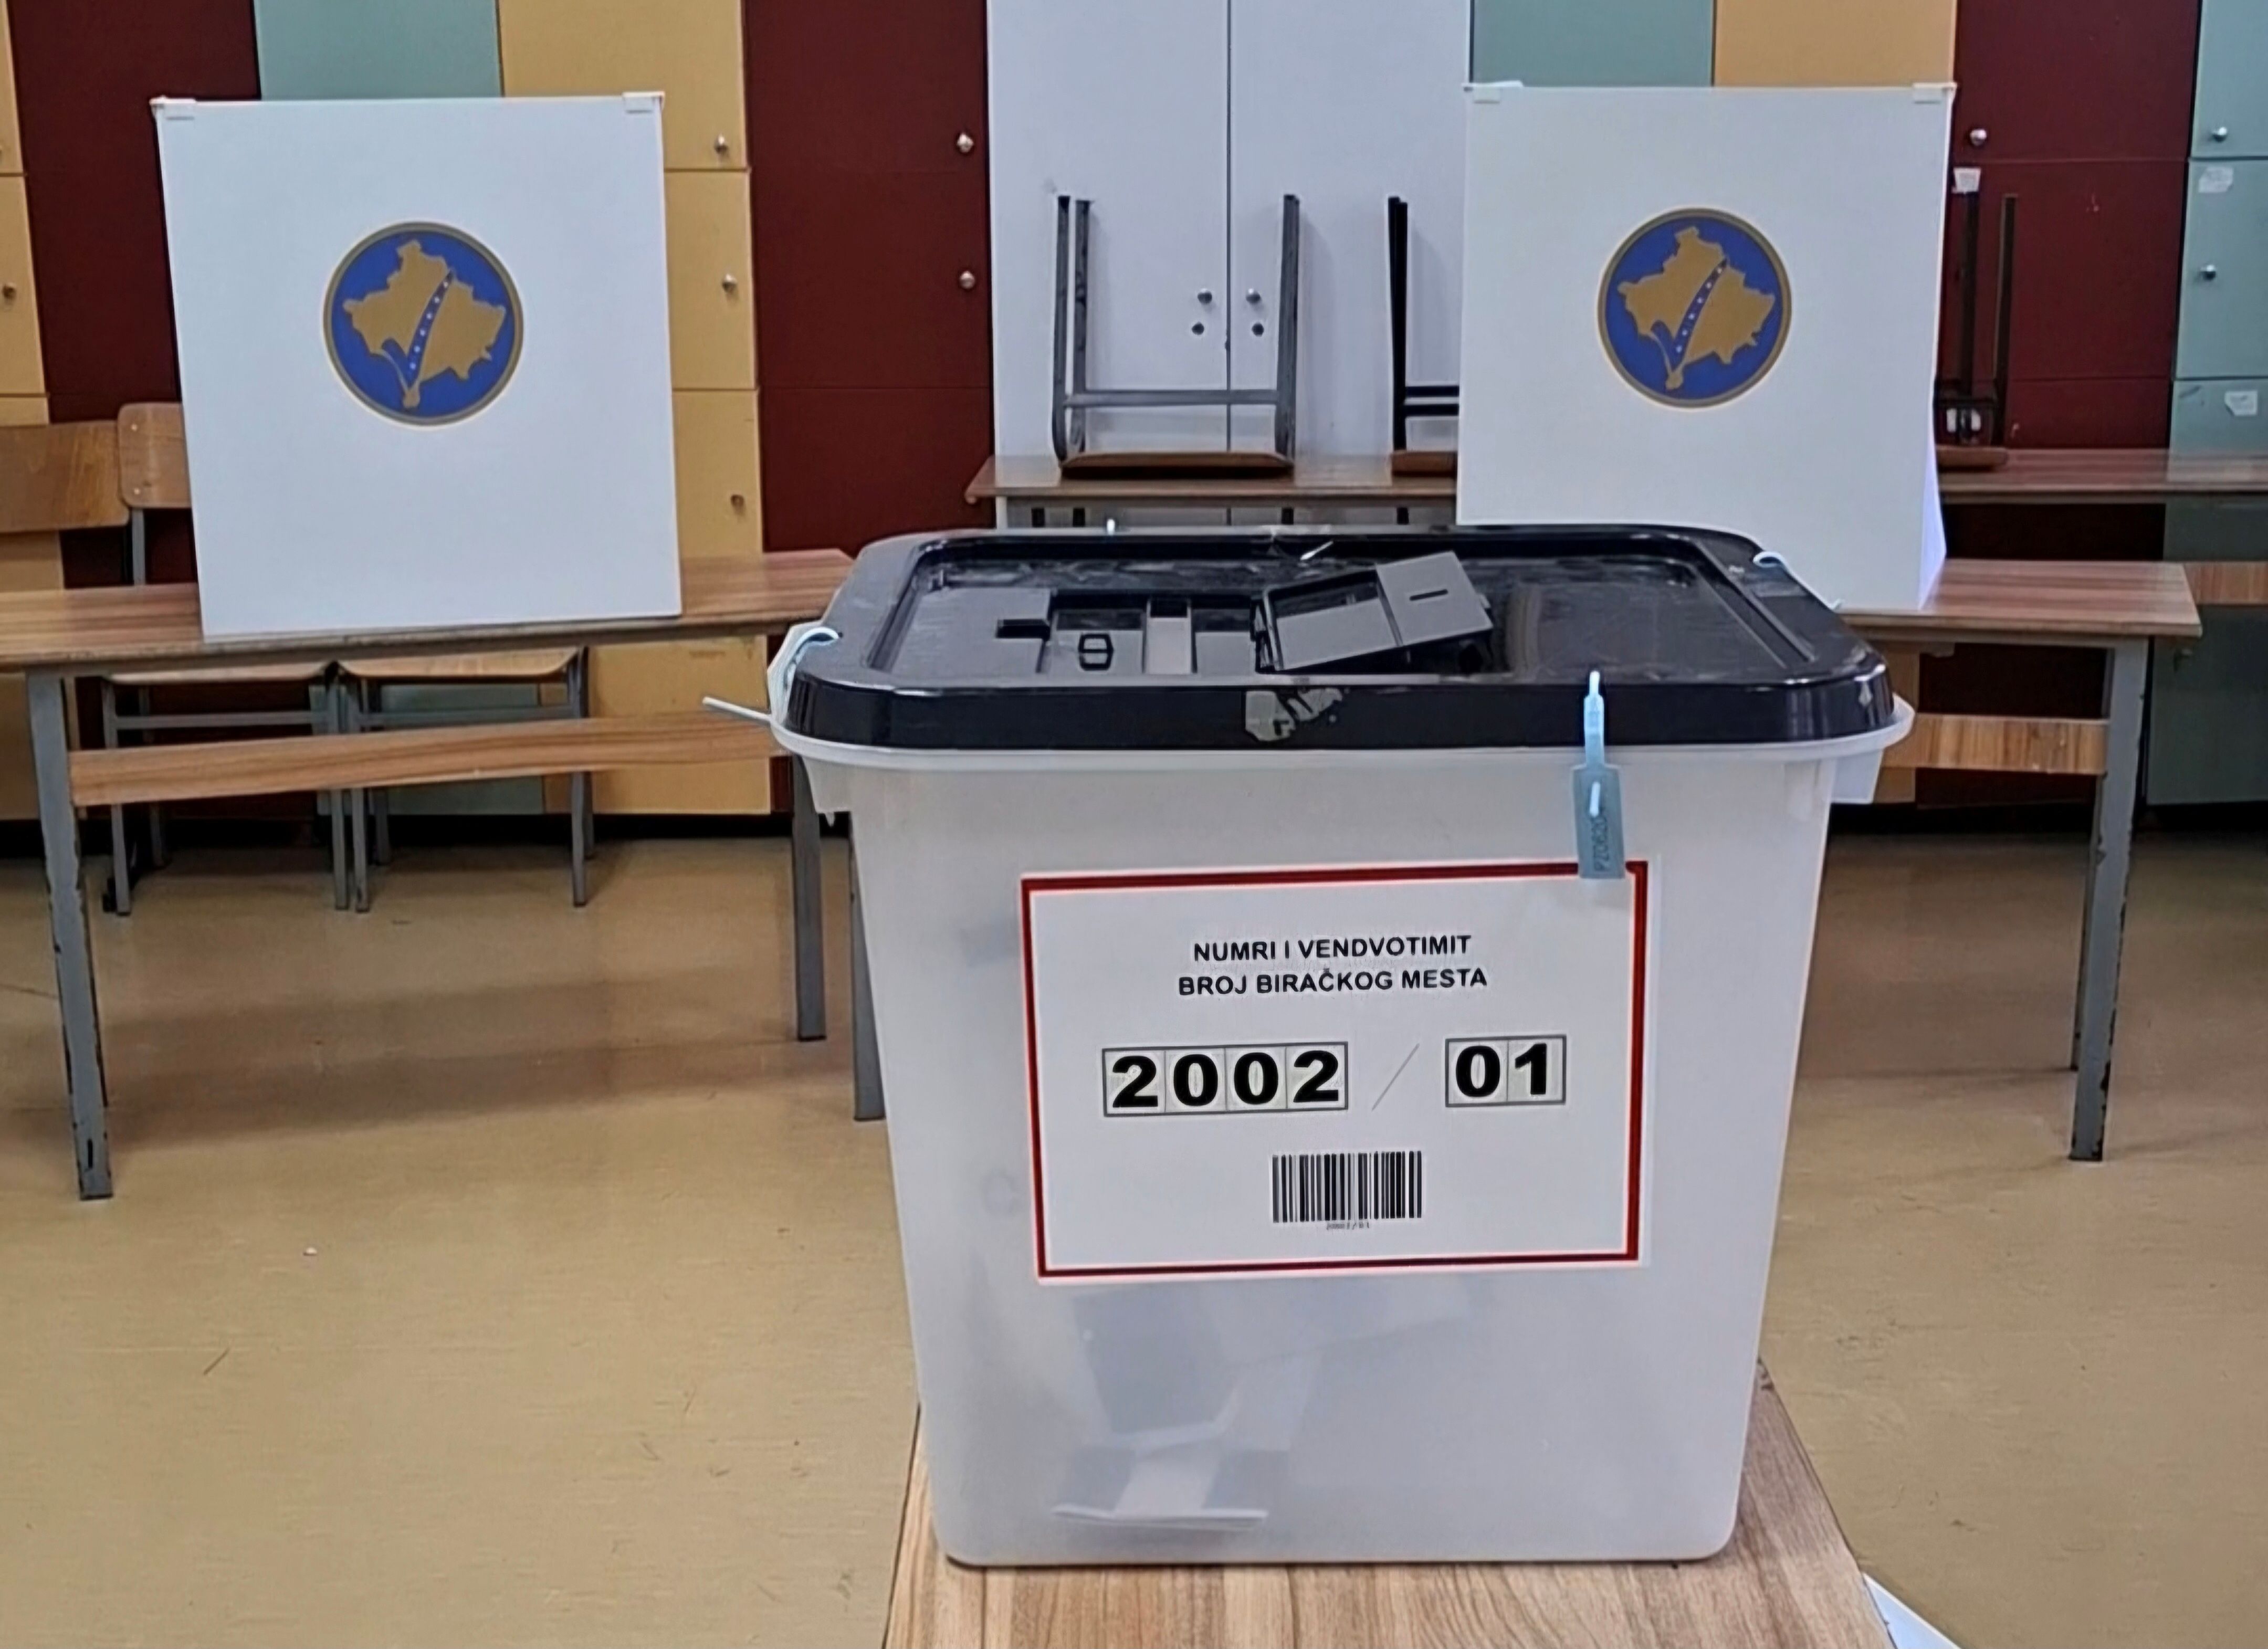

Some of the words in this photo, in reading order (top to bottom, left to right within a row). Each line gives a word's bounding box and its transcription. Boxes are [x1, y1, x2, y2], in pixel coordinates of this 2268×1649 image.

[1194, 941, 1276, 961] NUMRI
[1284, 940, 1289, 959] I
[1298, 935, 1472, 959] VENDVOTIMIT
[1179, 974, 1247, 996] BROJ
[1256, 968, 1393, 994] BIRAČKOG
[1402, 968, 1487, 989] MESTA
[1112, 1050, 1339, 1108] 2002
[1456, 1043, 1547, 1097] 01
